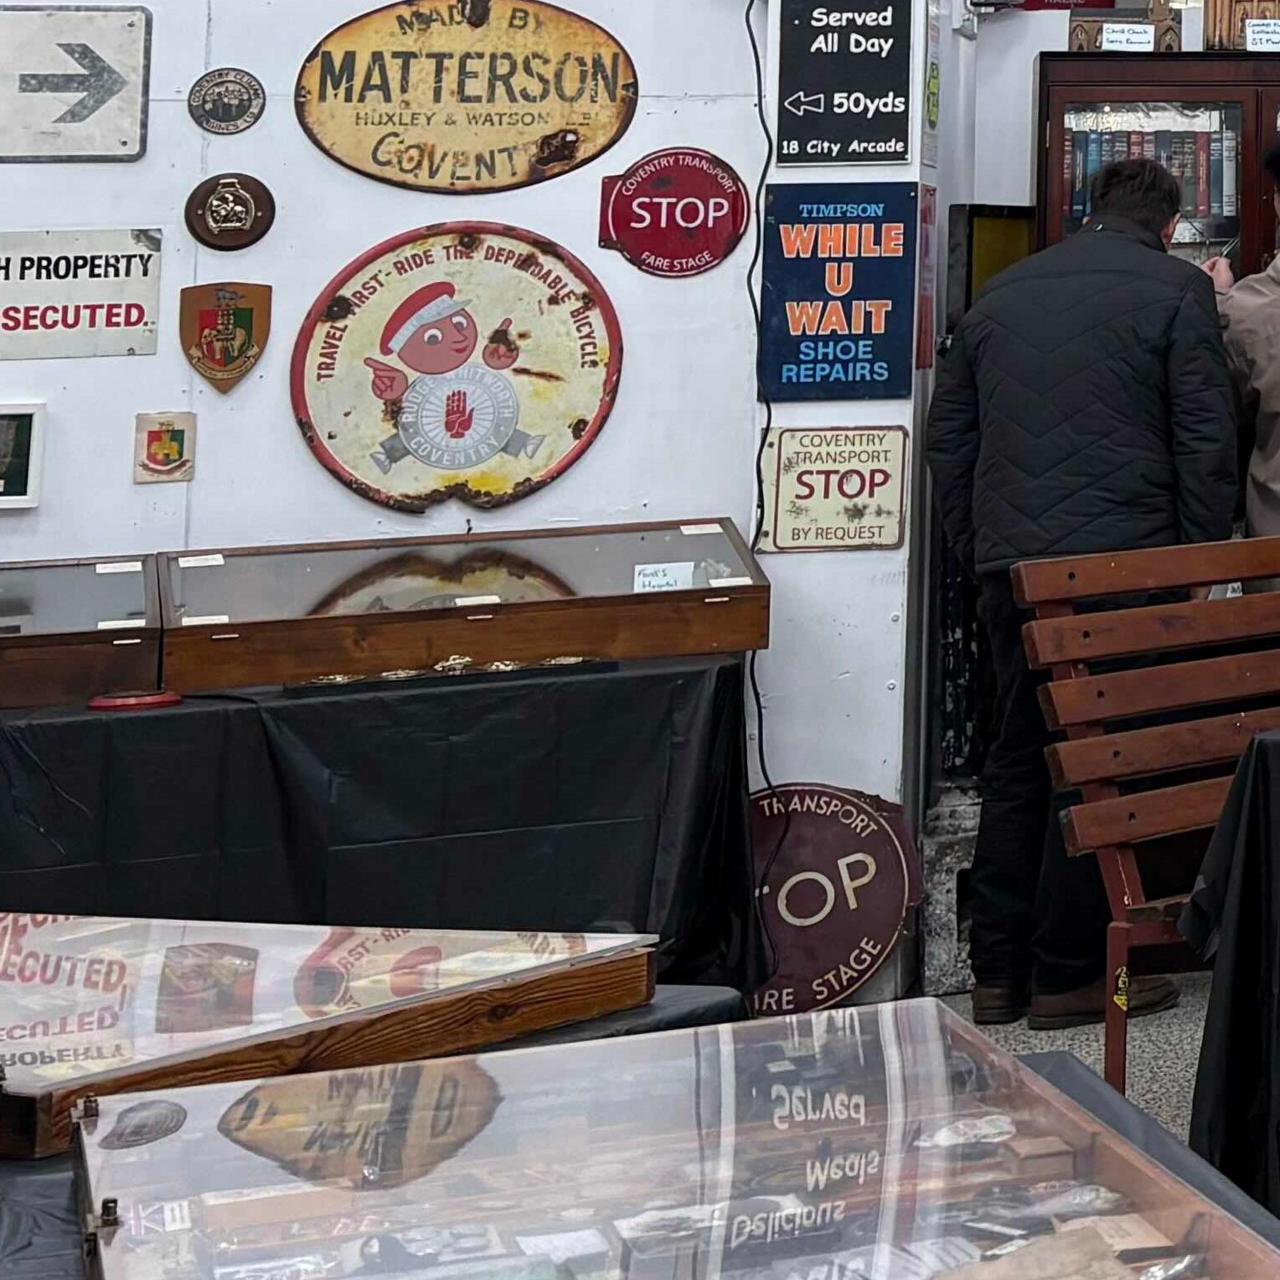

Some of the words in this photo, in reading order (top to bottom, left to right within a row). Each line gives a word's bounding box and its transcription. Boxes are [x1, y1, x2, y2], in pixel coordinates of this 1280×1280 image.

[810, 5, 894, 28] Served
[810, 32, 840, 53] All
[849, 33, 894, 58] Day
[317, 50, 622, 104] MATTERSON
[355, 111, 437, 127] HUXLEY
[448, 112, 458, 127] &
[465, 112, 551, 127] WATSON
[832, 91, 906, 119] 50yds
[371, 130, 540, 184] COVENT
[781, 140, 800, 154] 18
[806, 140, 841, 157] City
[848, 138, 905, 153] Arcade
[622, 155, 676, 196] COVENTRY
[678, 154, 737, 194] TRANSPORT
[630, 197, 730, 229] STOP
[799, 204, 885, 218] TIMPSON
[779, 223, 905, 259] WHILE
[19, 253, 154, 281] PROPERTY
[641, 251, 672, 270] FARE
[673, 250, 715, 271] STAGE
[825, 262, 854, 297] U
[316, 321, 348, 382] TRAVEL
[392, 248, 435, 277] RIDE
[484, 244, 574, 304] DEPEDABLE
[785, 300, 892, 336] WAIT
[799, 340, 874, 360] SHOE
[781, 362, 889, 384] REPAIRS
[410, 436, 501, 466] COVENTRY
[799, 433, 887, 448] COVENTRY
[794, 450, 891, 465] TRANSPORT
[794, 468, 891, 500] STOP
[791, 527, 812, 541] BY
[815, 525, 885, 541] REQUEST
[811, 936, 883, 1000] STAGE
